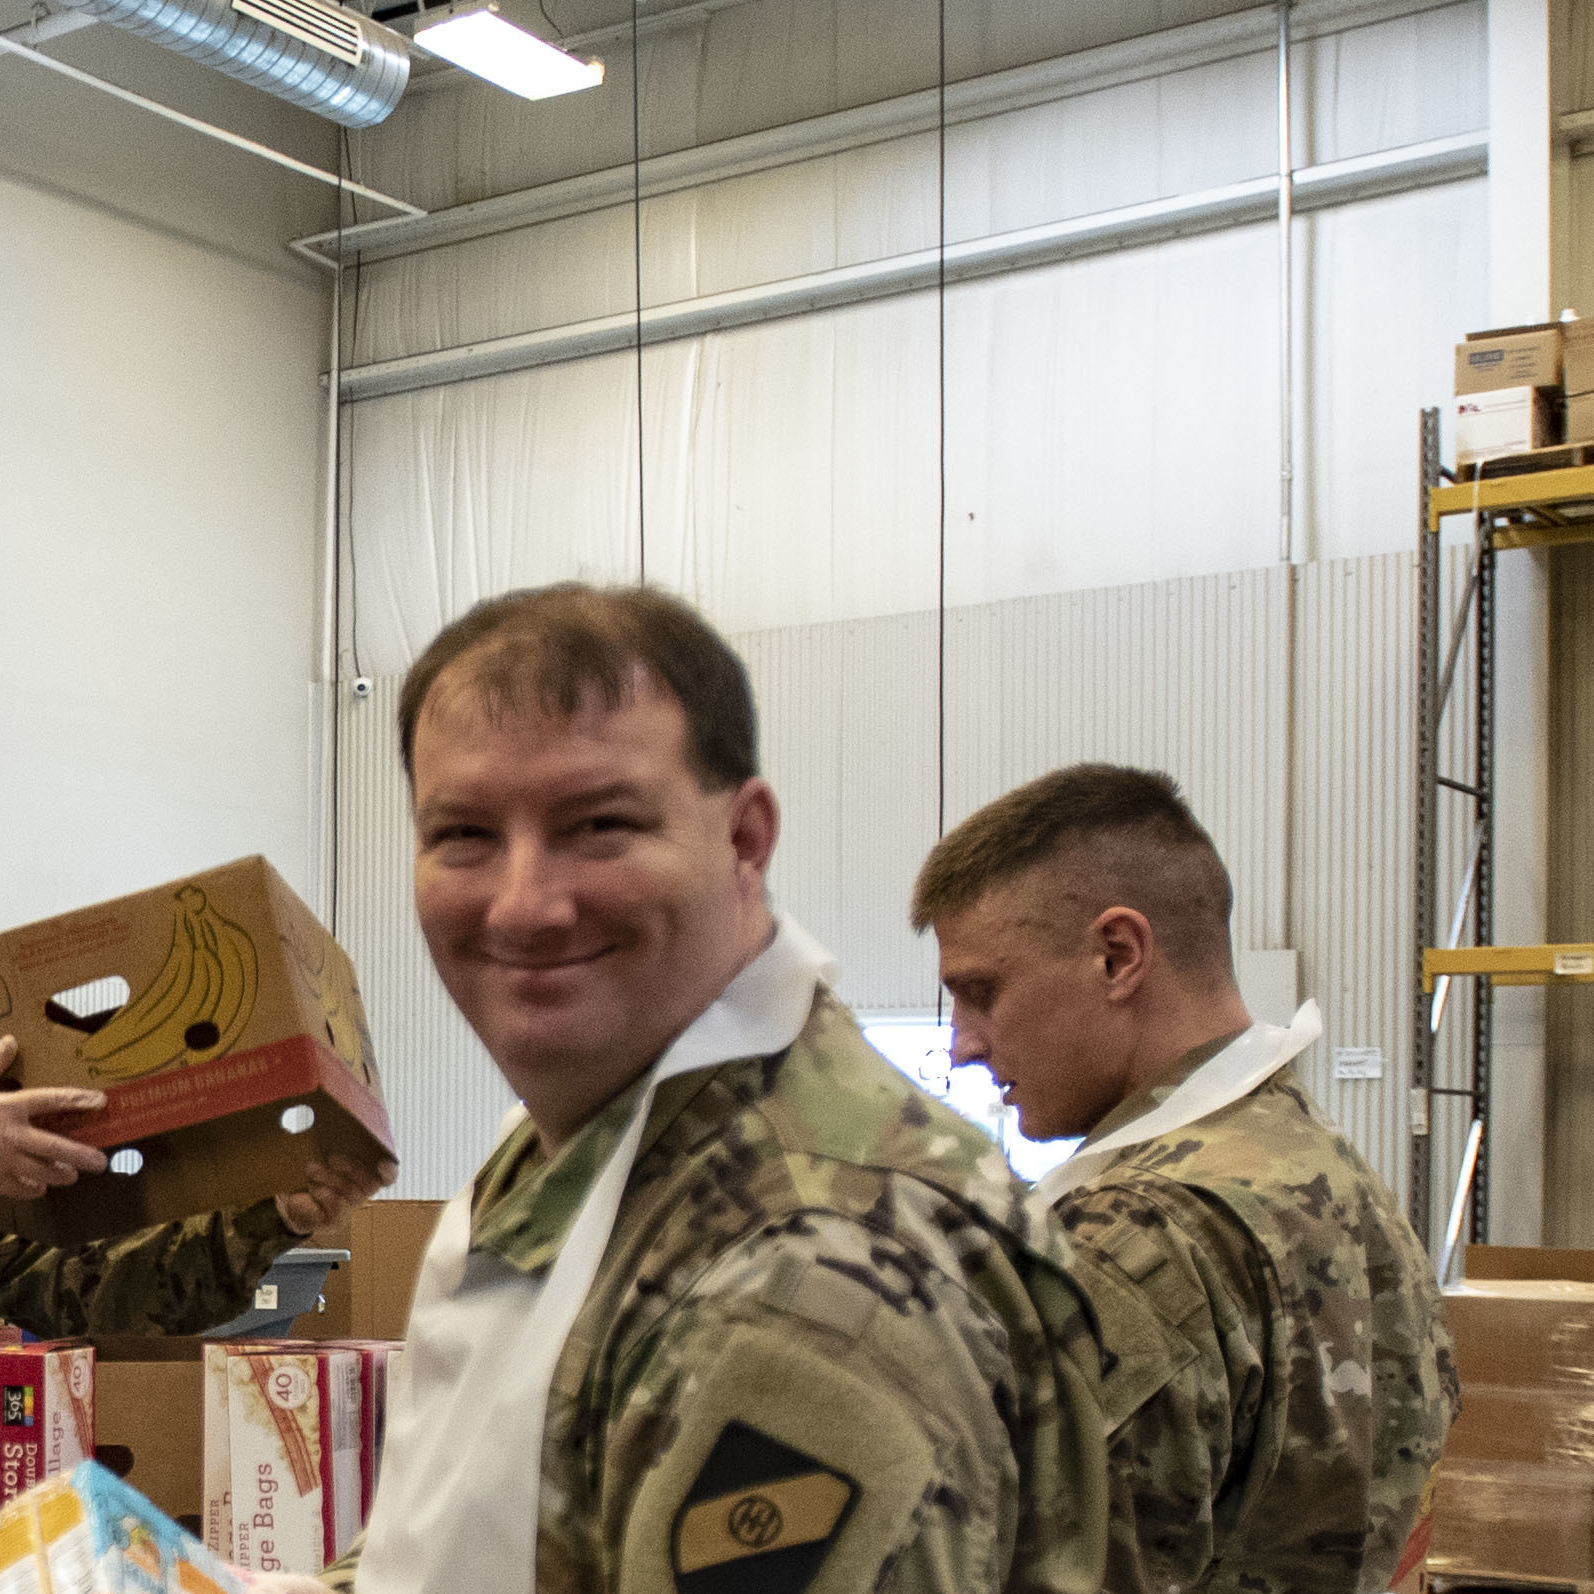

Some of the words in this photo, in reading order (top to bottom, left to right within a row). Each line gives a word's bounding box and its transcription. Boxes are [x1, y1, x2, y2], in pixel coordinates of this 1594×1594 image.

[8, 1390, 22, 1421] 365
[276, 1373, 293, 1402] 40
[253, 1463, 279, 1530] Bags
[238, 1521, 250, 1571] IPPER
